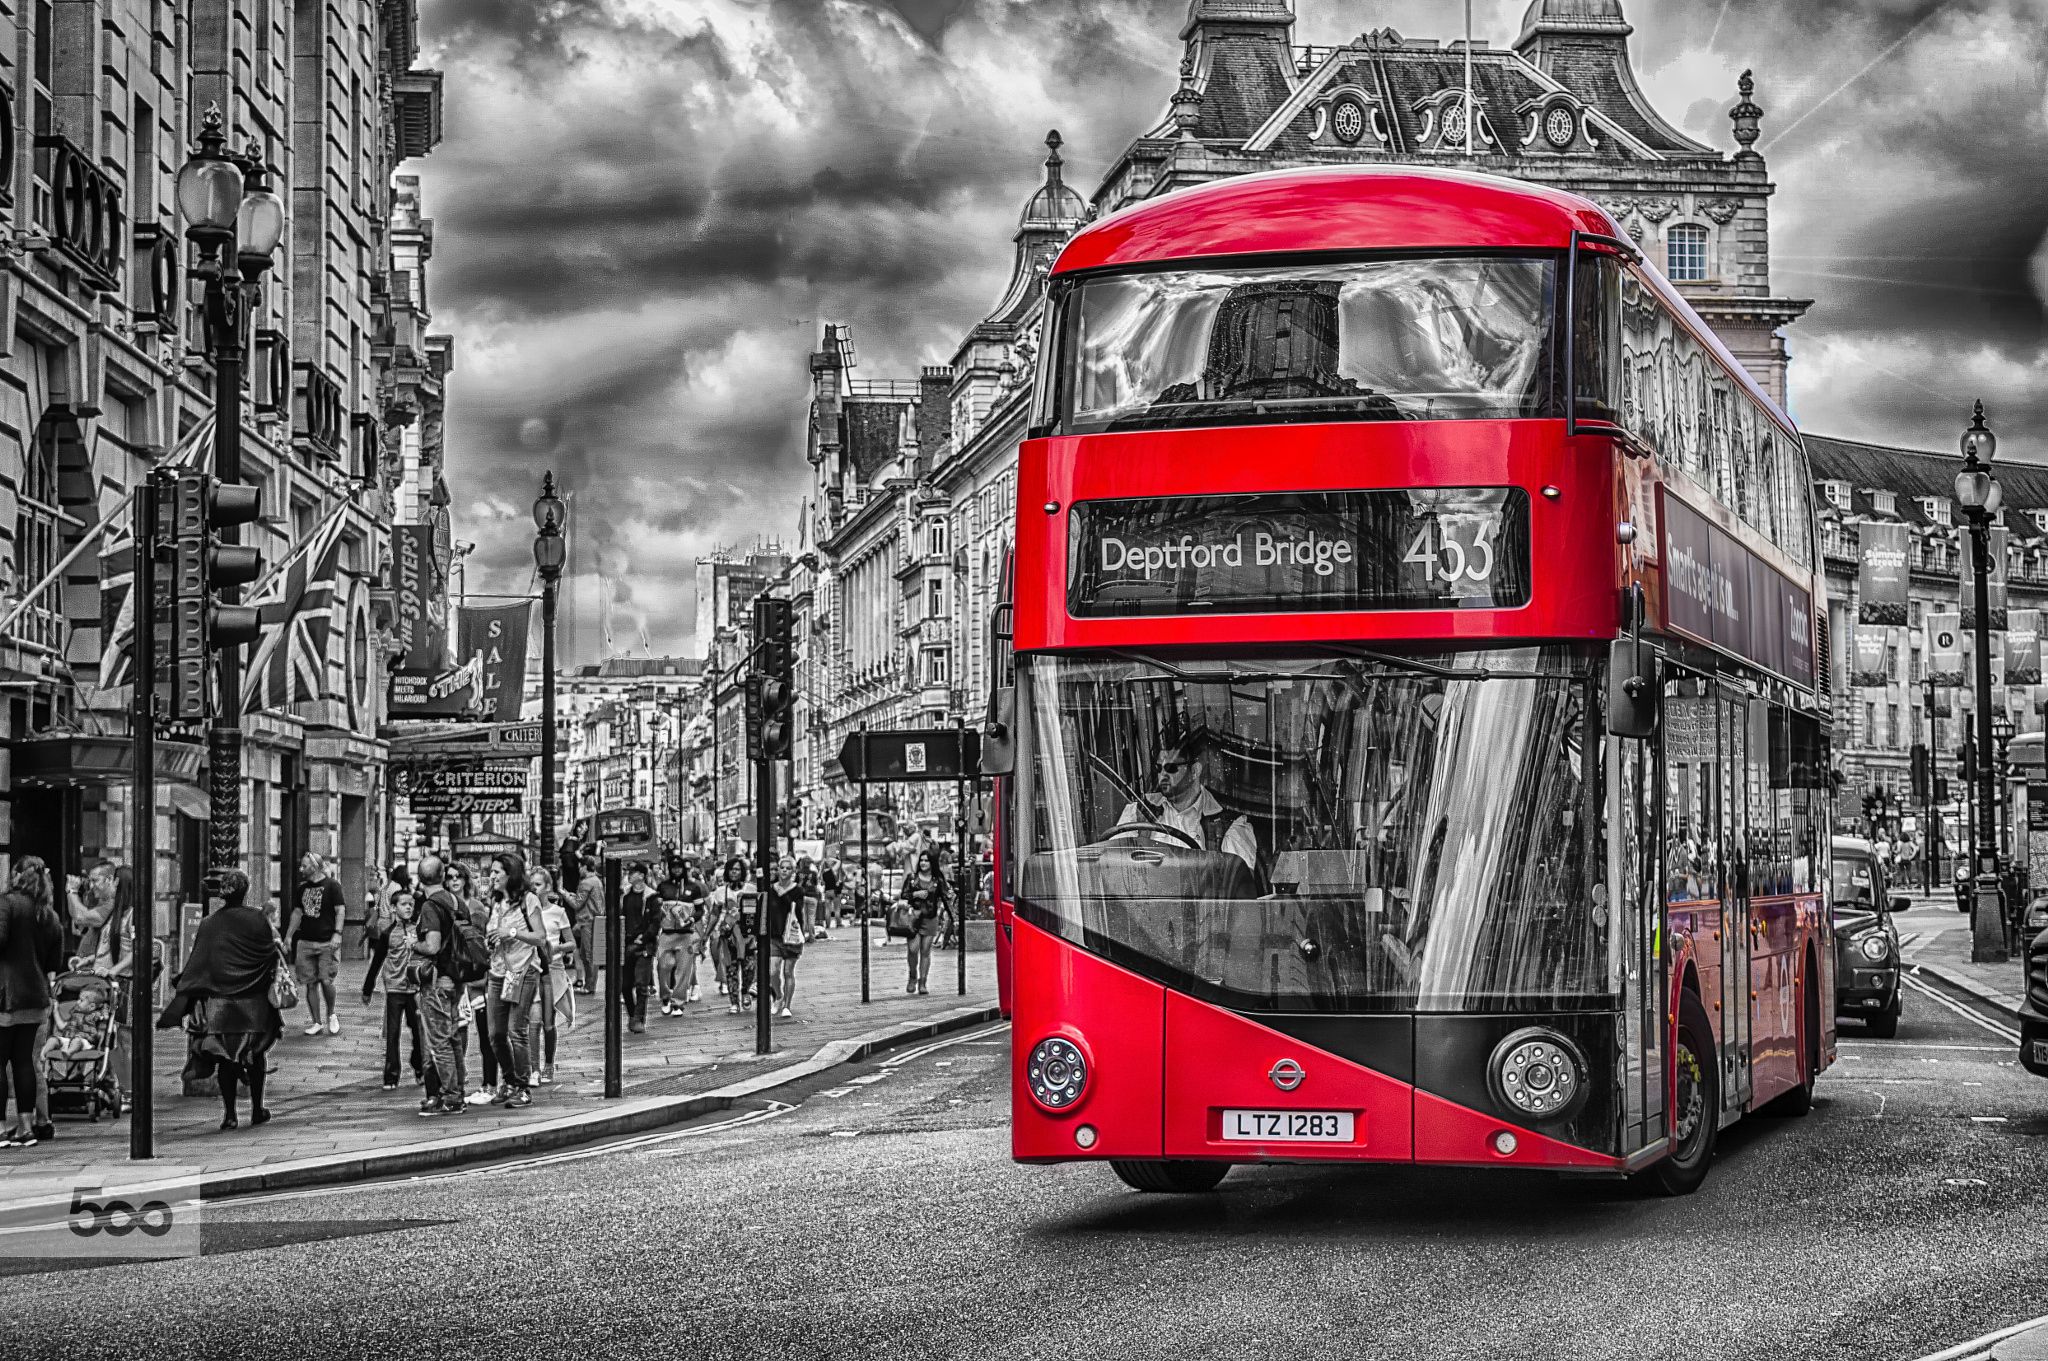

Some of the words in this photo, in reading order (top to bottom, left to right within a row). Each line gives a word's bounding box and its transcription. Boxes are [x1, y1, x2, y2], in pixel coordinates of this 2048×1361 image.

[1101, 532, 1243, 580] Deptford
[1255, 530, 1352, 576] Bridge
[1402, 516, 1494, 582] 453
[401, 590, 421, 620] 39
[483, 620, 503, 716] SALE
[505, 728, 543, 742] CRITERI
[432, 771, 526, 786] CRITERION
[447, 794, 475, 813] 39
[1237, 1113, 1281, 1136] LTZ
[1288, 1114, 1338, 1137] 1283
